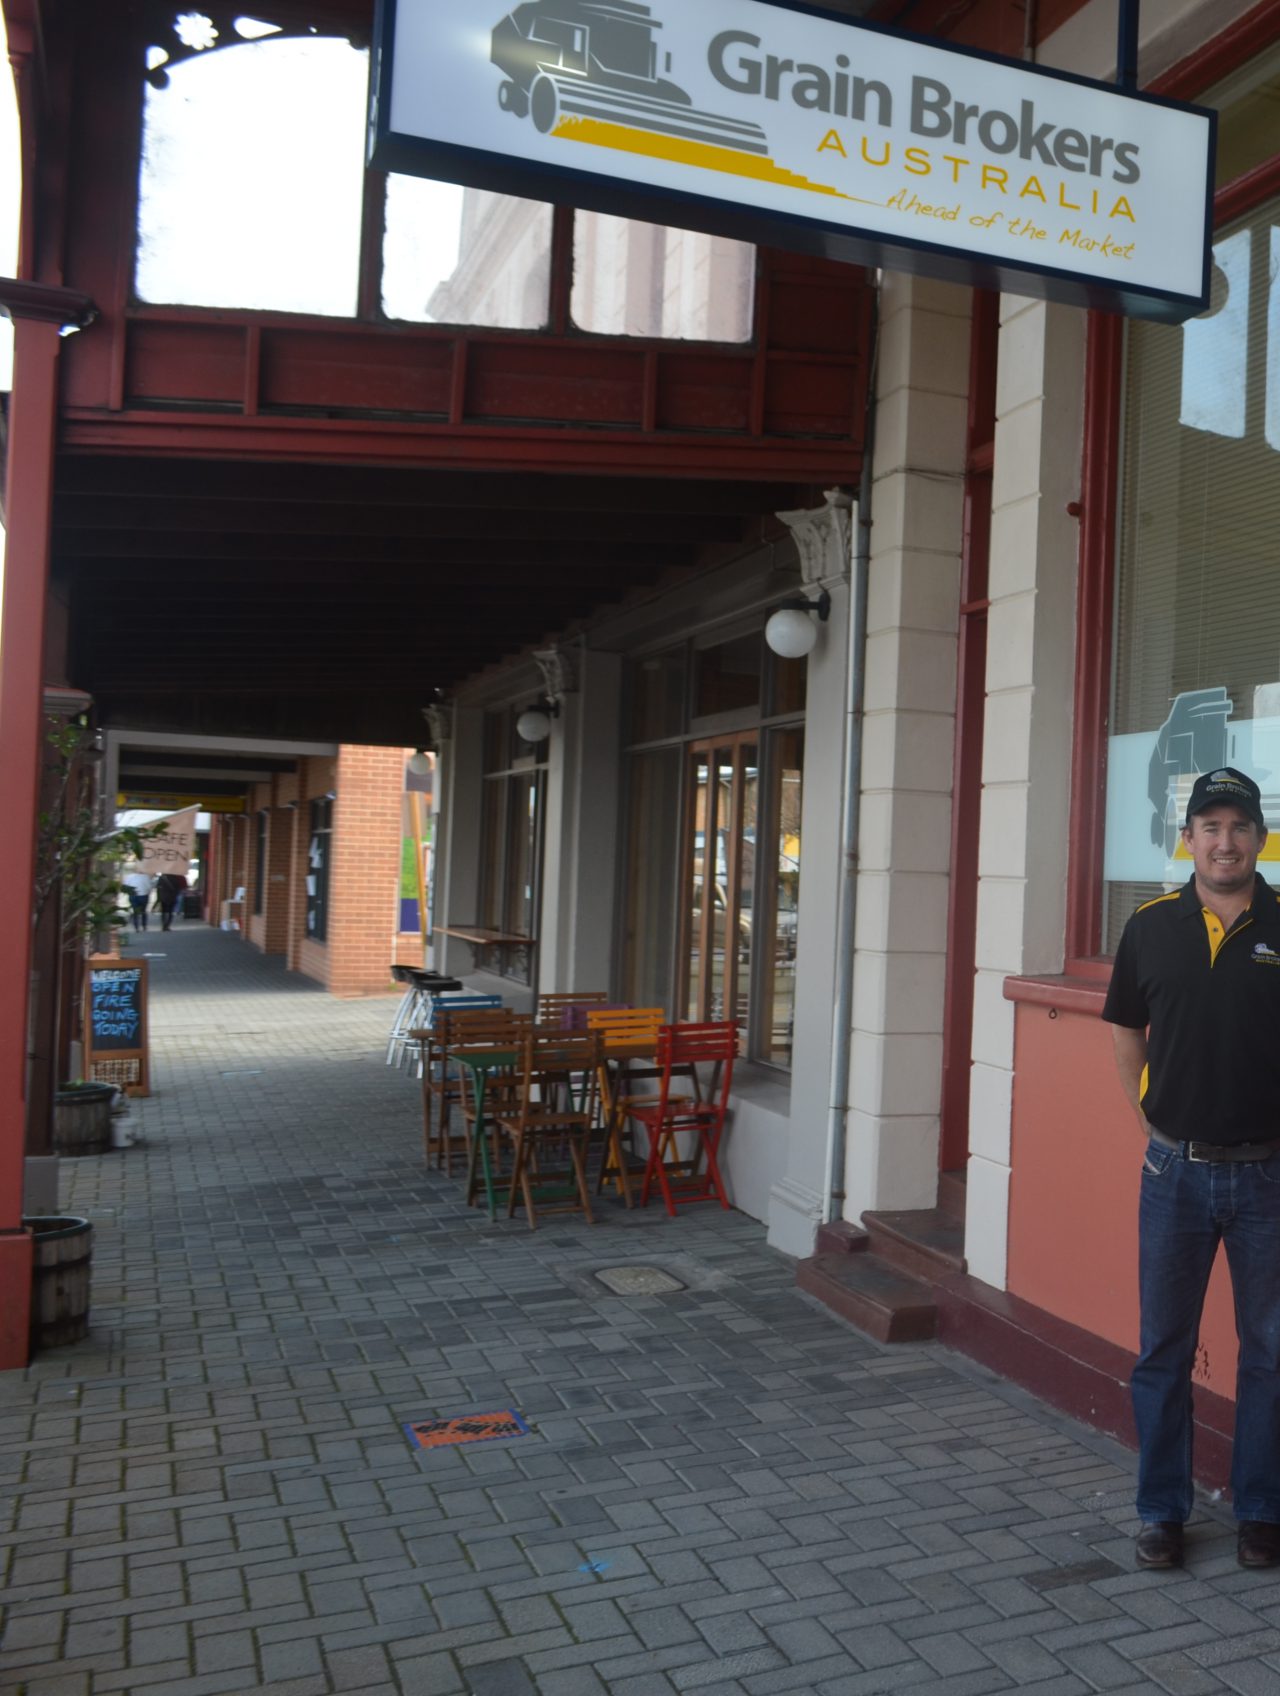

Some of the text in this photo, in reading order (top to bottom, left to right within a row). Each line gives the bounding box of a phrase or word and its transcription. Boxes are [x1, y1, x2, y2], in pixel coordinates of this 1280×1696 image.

[707, 29, 1142, 185] Grain Brokers
[816, 128, 1137, 223] AUSTRALIA
[886, 188, 1136, 260] Ahead of the Market
[92, 981, 136, 993] OPEN
[94, 994, 132, 1008] FIRE
[92, 1007, 139, 1020] GOING
[95, 1021, 138, 1039] TODAY
